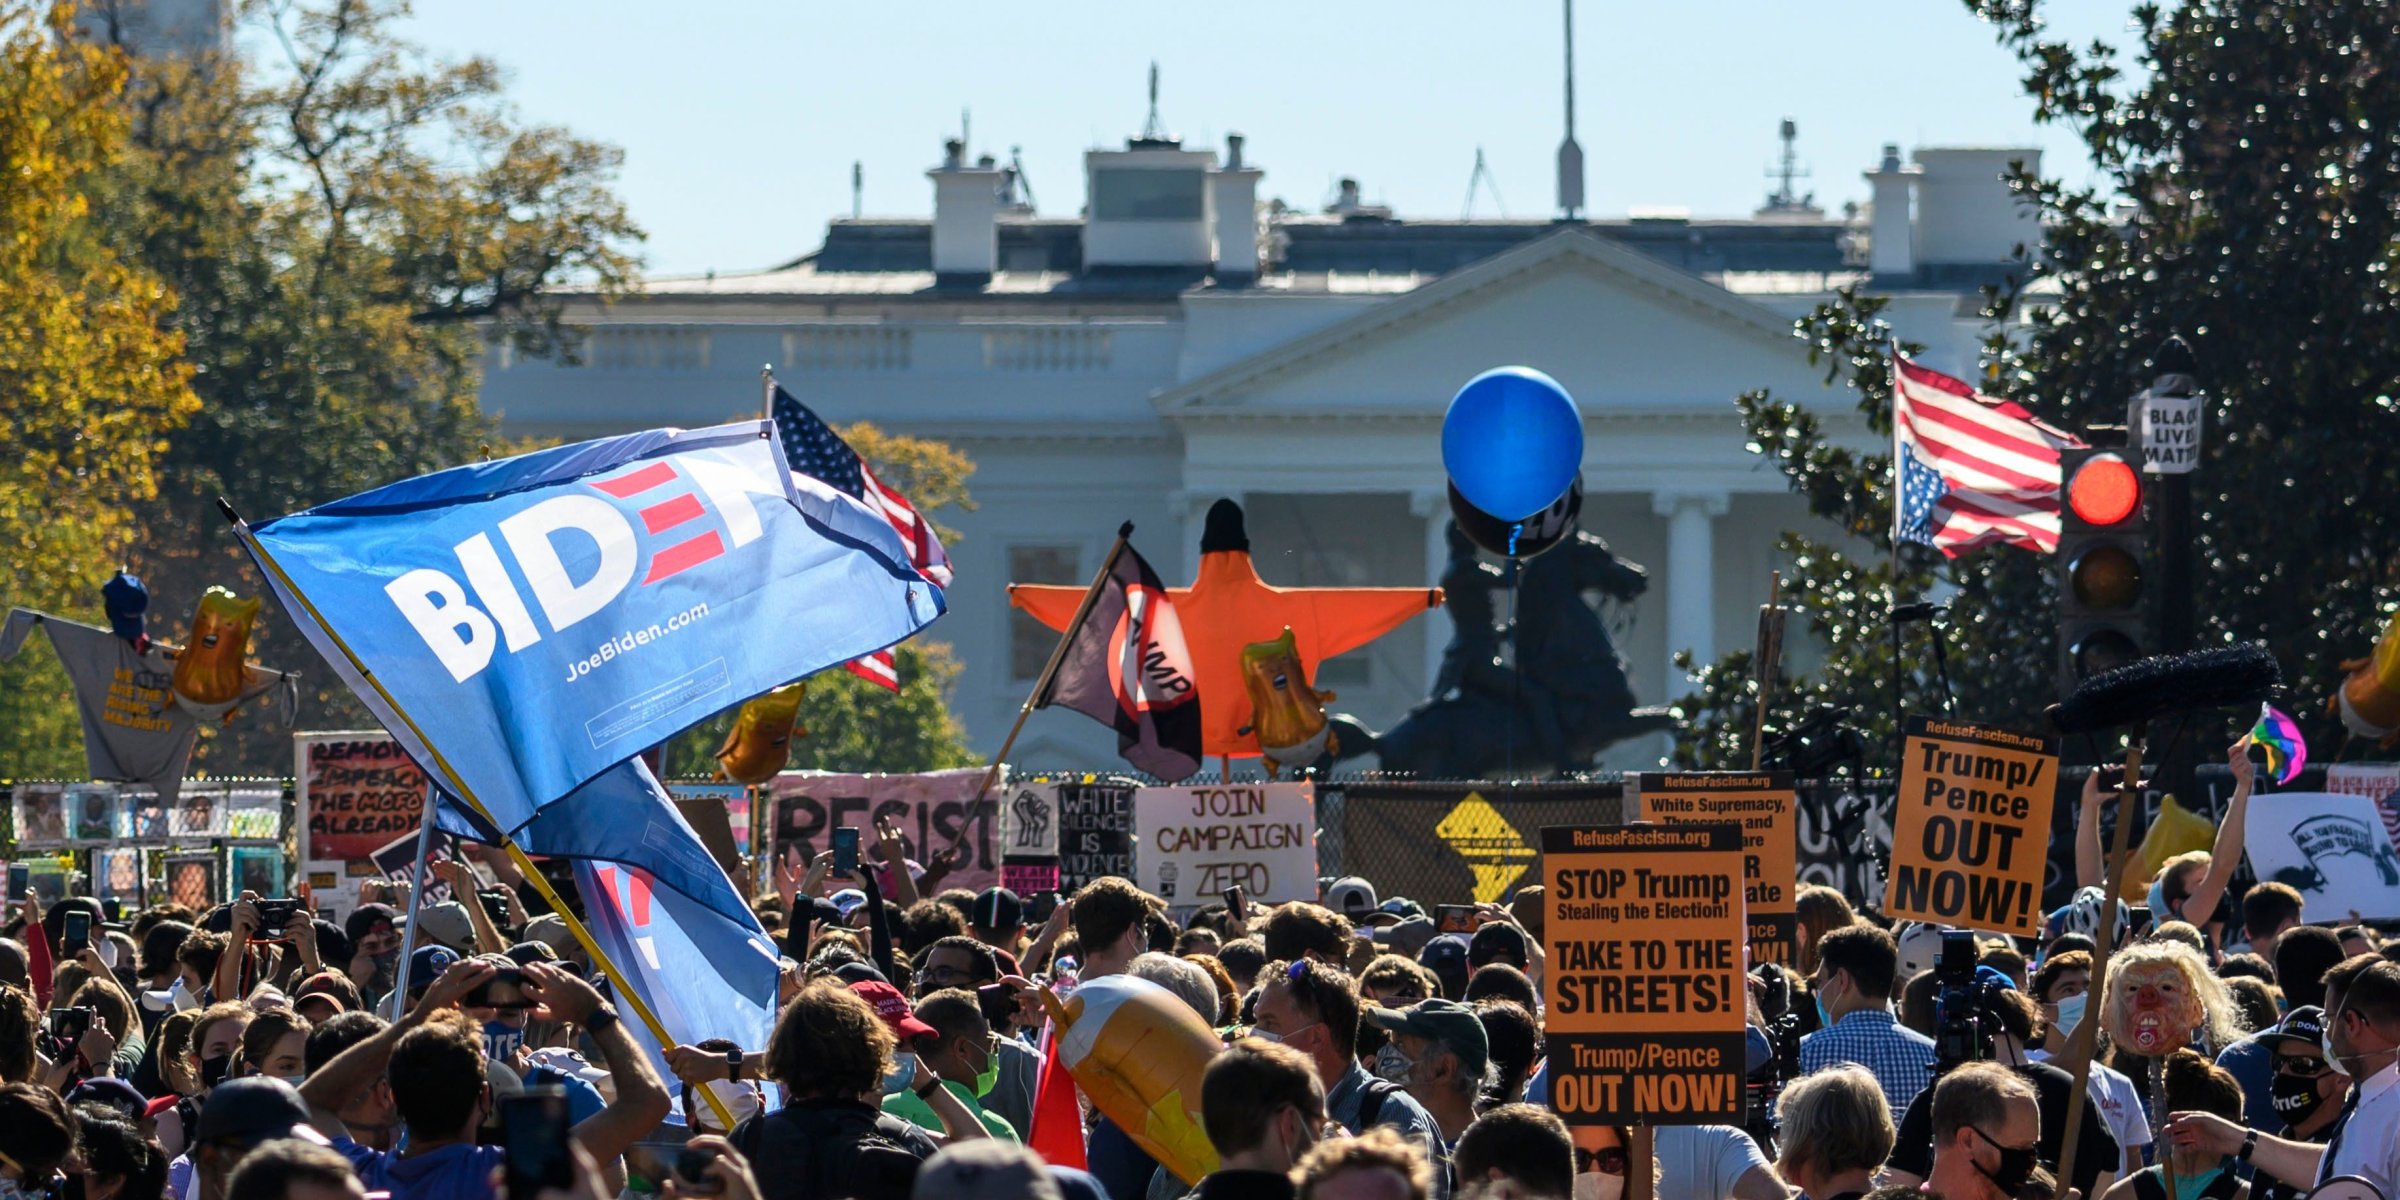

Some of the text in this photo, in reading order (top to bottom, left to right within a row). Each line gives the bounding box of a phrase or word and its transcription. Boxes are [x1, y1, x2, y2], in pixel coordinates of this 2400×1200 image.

[2151, 409, 2197, 424] BLAC
[2156, 428, 2194, 443] LIVE
[2143, 446, 2197, 463] MATT
[566, 602, 709, 682] JoeBiden.com
[103, 711, 173, 732] MAJORITY
[1926, 721, 2044, 750] RefuseFascism.org
[312, 741, 404, 760] REMO
[1920, 742, 2045, 790] Trump/
[1664, 776, 1771, 788] RefuseFascism.org
[308, 793, 353, 811] THE
[1062, 788, 1129, 814] WHITE
[1191, 789, 1265, 818] JOIN
[1651, 798, 1786, 815] White Supremacy,
[1923, 777, 2029, 820] Pence
[309, 814, 421, 834] ALREADY
[1061, 813, 1128, 831] SILENCE
[1745, 816, 1773, 828] and
[1081, 832, 1100, 853] IS
[1156, 823, 1303, 853] CAMPAIGN
[1573, 830, 1711, 849] RefuseFascism.org
[1922, 815, 2023, 871] OUT
[1060, 854, 1128, 875] VIOLENCE
[1196, 862, 1270, 897] ZERO
[1556, 868, 1730, 904] STOP Trump
[1746, 883, 1781, 902] ate
[1894, 865, 2033, 928] NOW!
[1557, 902, 1729, 922] Stealing the Election!
[1555, 940, 1733, 971] TAKE TO THE
[1556, 975, 1731, 1014] STREETS!
[2283, 1020, 2320, 1033] EEDOM
[483, 1033, 520, 1061] OTE
[1571, 1043, 1720, 1072] Trump/Pence
[1555, 1073, 1736, 1113] OUT NOW!
[2272, 1092, 2312, 1112] TICE
